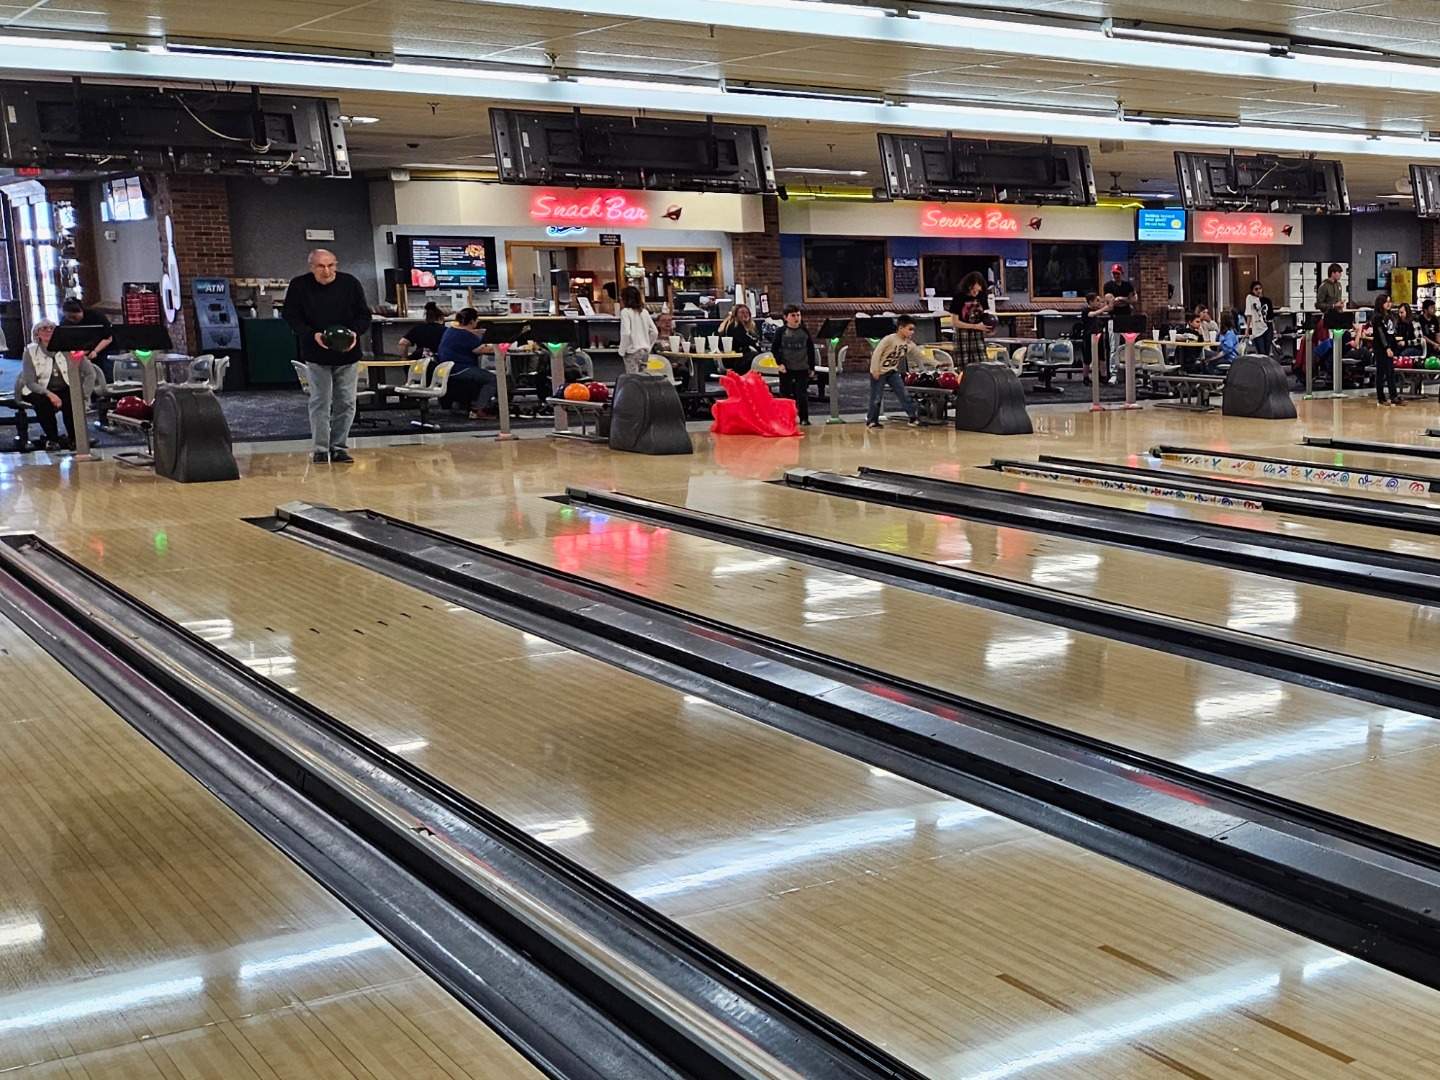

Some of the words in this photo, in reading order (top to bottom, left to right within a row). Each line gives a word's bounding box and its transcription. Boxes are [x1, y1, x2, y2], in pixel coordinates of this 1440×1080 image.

[531, 196, 603, 218] Snack
[605, 196, 649, 220] Bar
[923, 210, 983, 229] Service
[986, 212, 1018, 230] Bar
[1203, 218, 1248, 239] Sports
[1249, 220, 1274, 238] Bar
[205, 284, 225, 293] ATM
